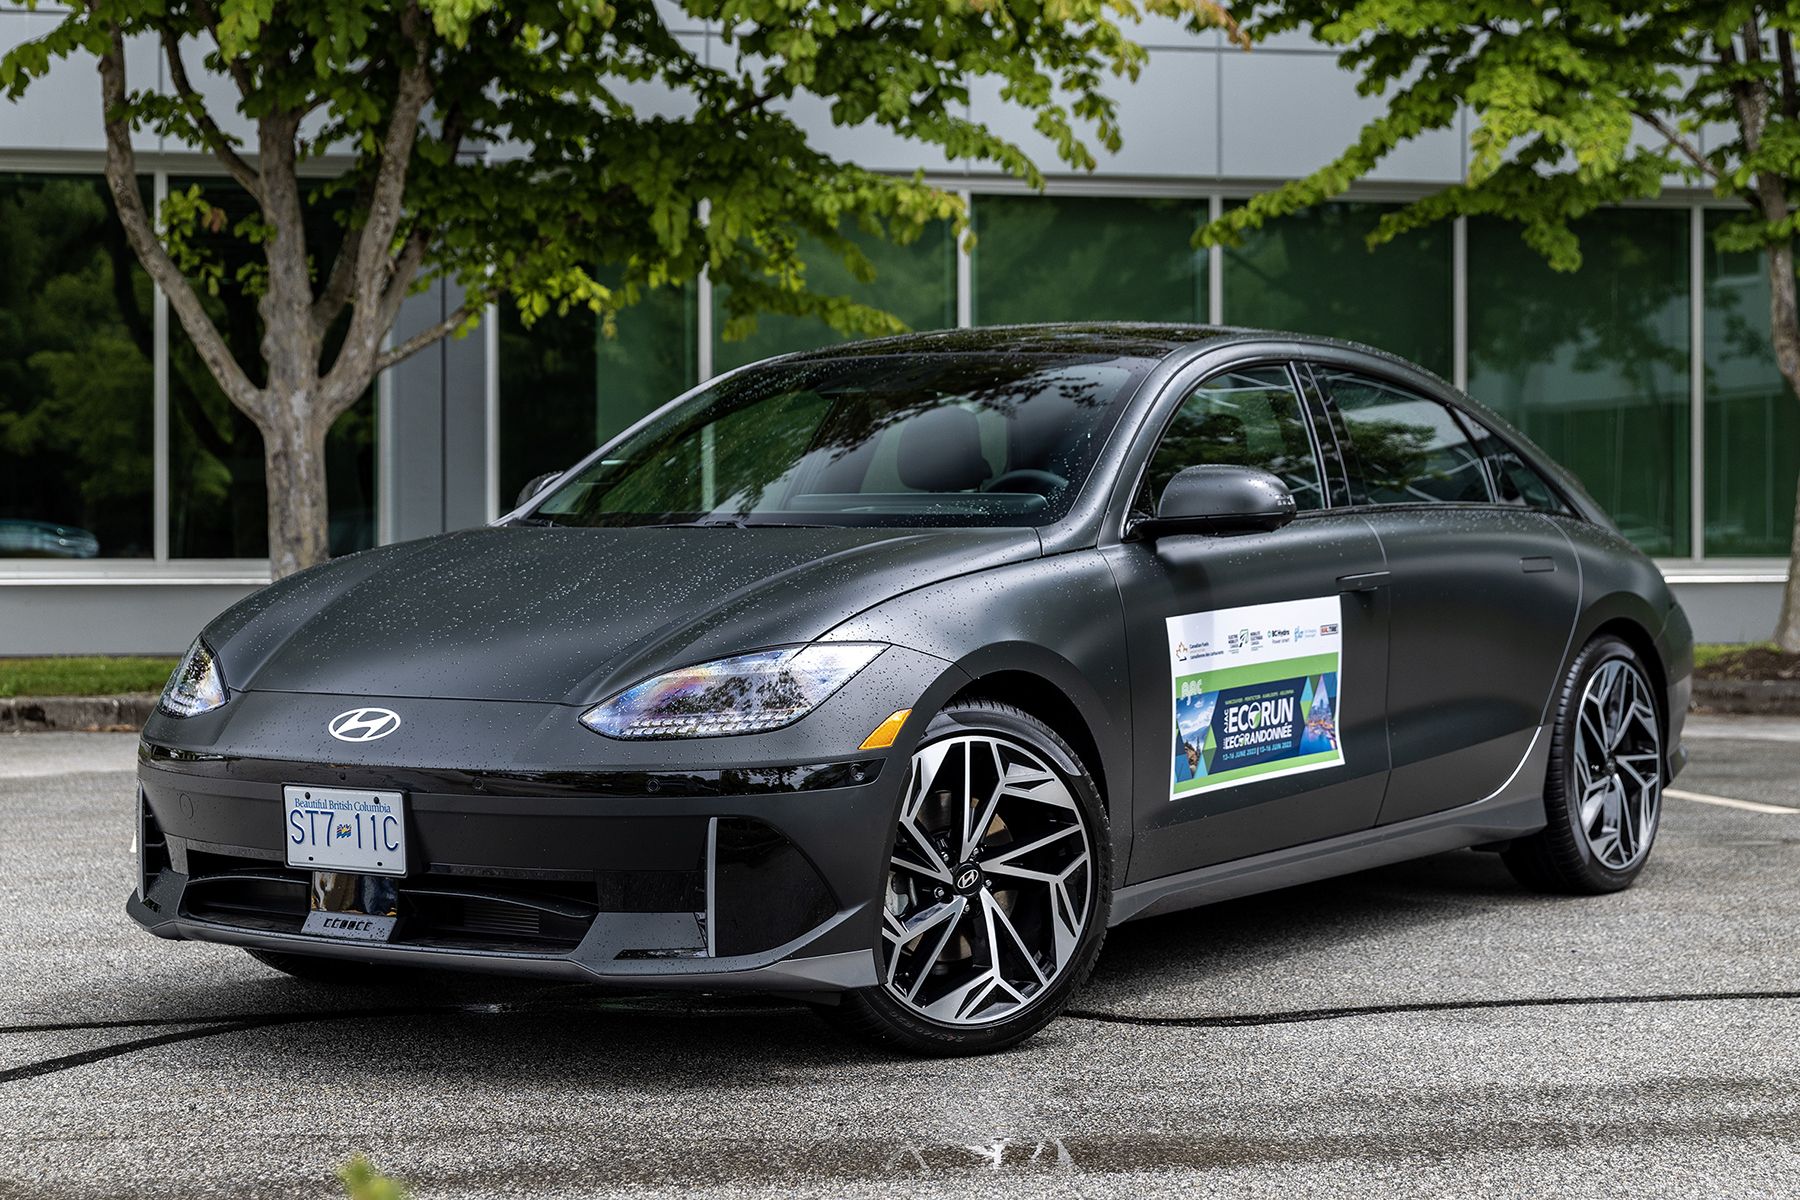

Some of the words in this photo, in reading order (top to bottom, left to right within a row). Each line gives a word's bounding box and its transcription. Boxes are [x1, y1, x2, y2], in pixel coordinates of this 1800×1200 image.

[1228, 697, 1294, 734] ECORUN
[295, 798, 328, 810] Beautiful
[329, 799, 353, 811] British
[354, 801, 391, 813] Columbia
[290, 809, 335, 847] ST7
[355, 813, 399, 851] 11C
